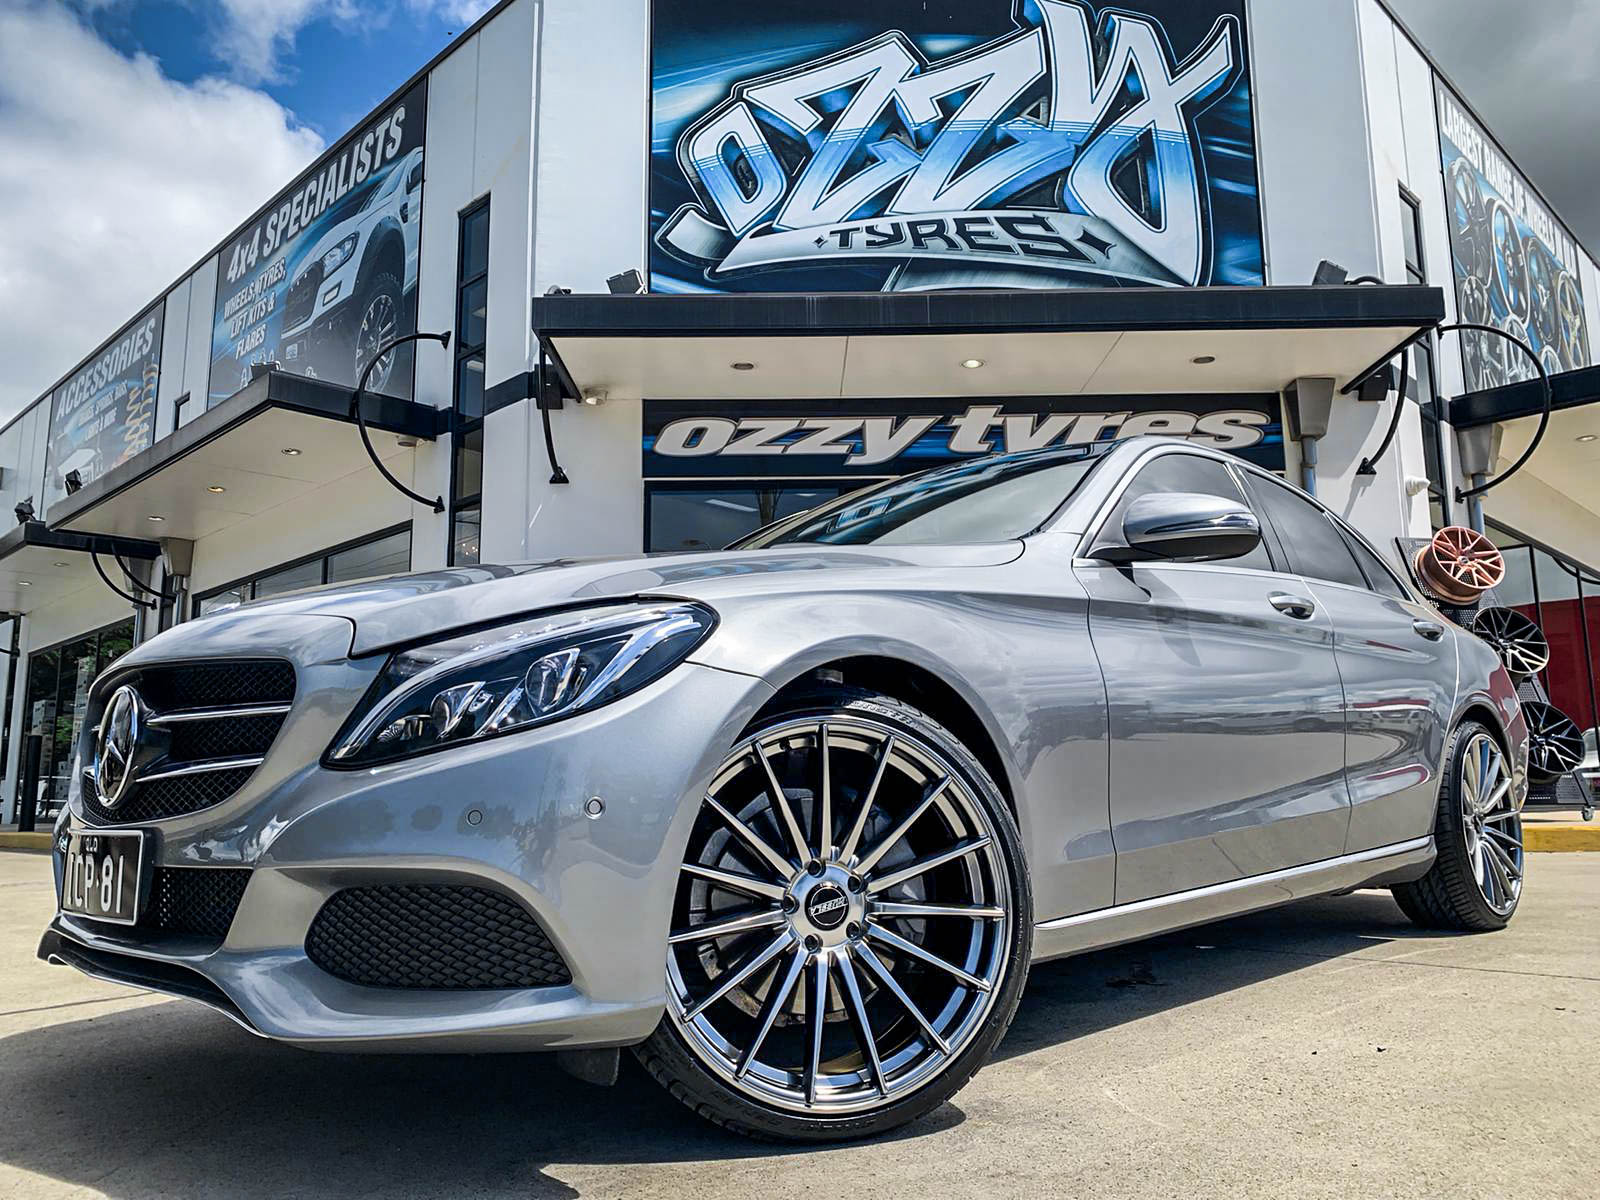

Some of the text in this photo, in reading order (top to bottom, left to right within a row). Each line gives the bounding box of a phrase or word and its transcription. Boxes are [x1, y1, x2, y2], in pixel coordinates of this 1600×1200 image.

[227, 104, 406, 283] 4x4 SPECIALISTS
[680, 0, 1242, 287] OZZY
[1439, 89, 1484, 174] LARGEST
[1484, 141, 1514, 208] RANGE
[828, 214, 1097, 264] TYRES
[56, 317, 156, 422] ACCESSORIES
[235, 323, 266, 360] FLARES
[653, 404, 1271, 465] ozzy tyres
